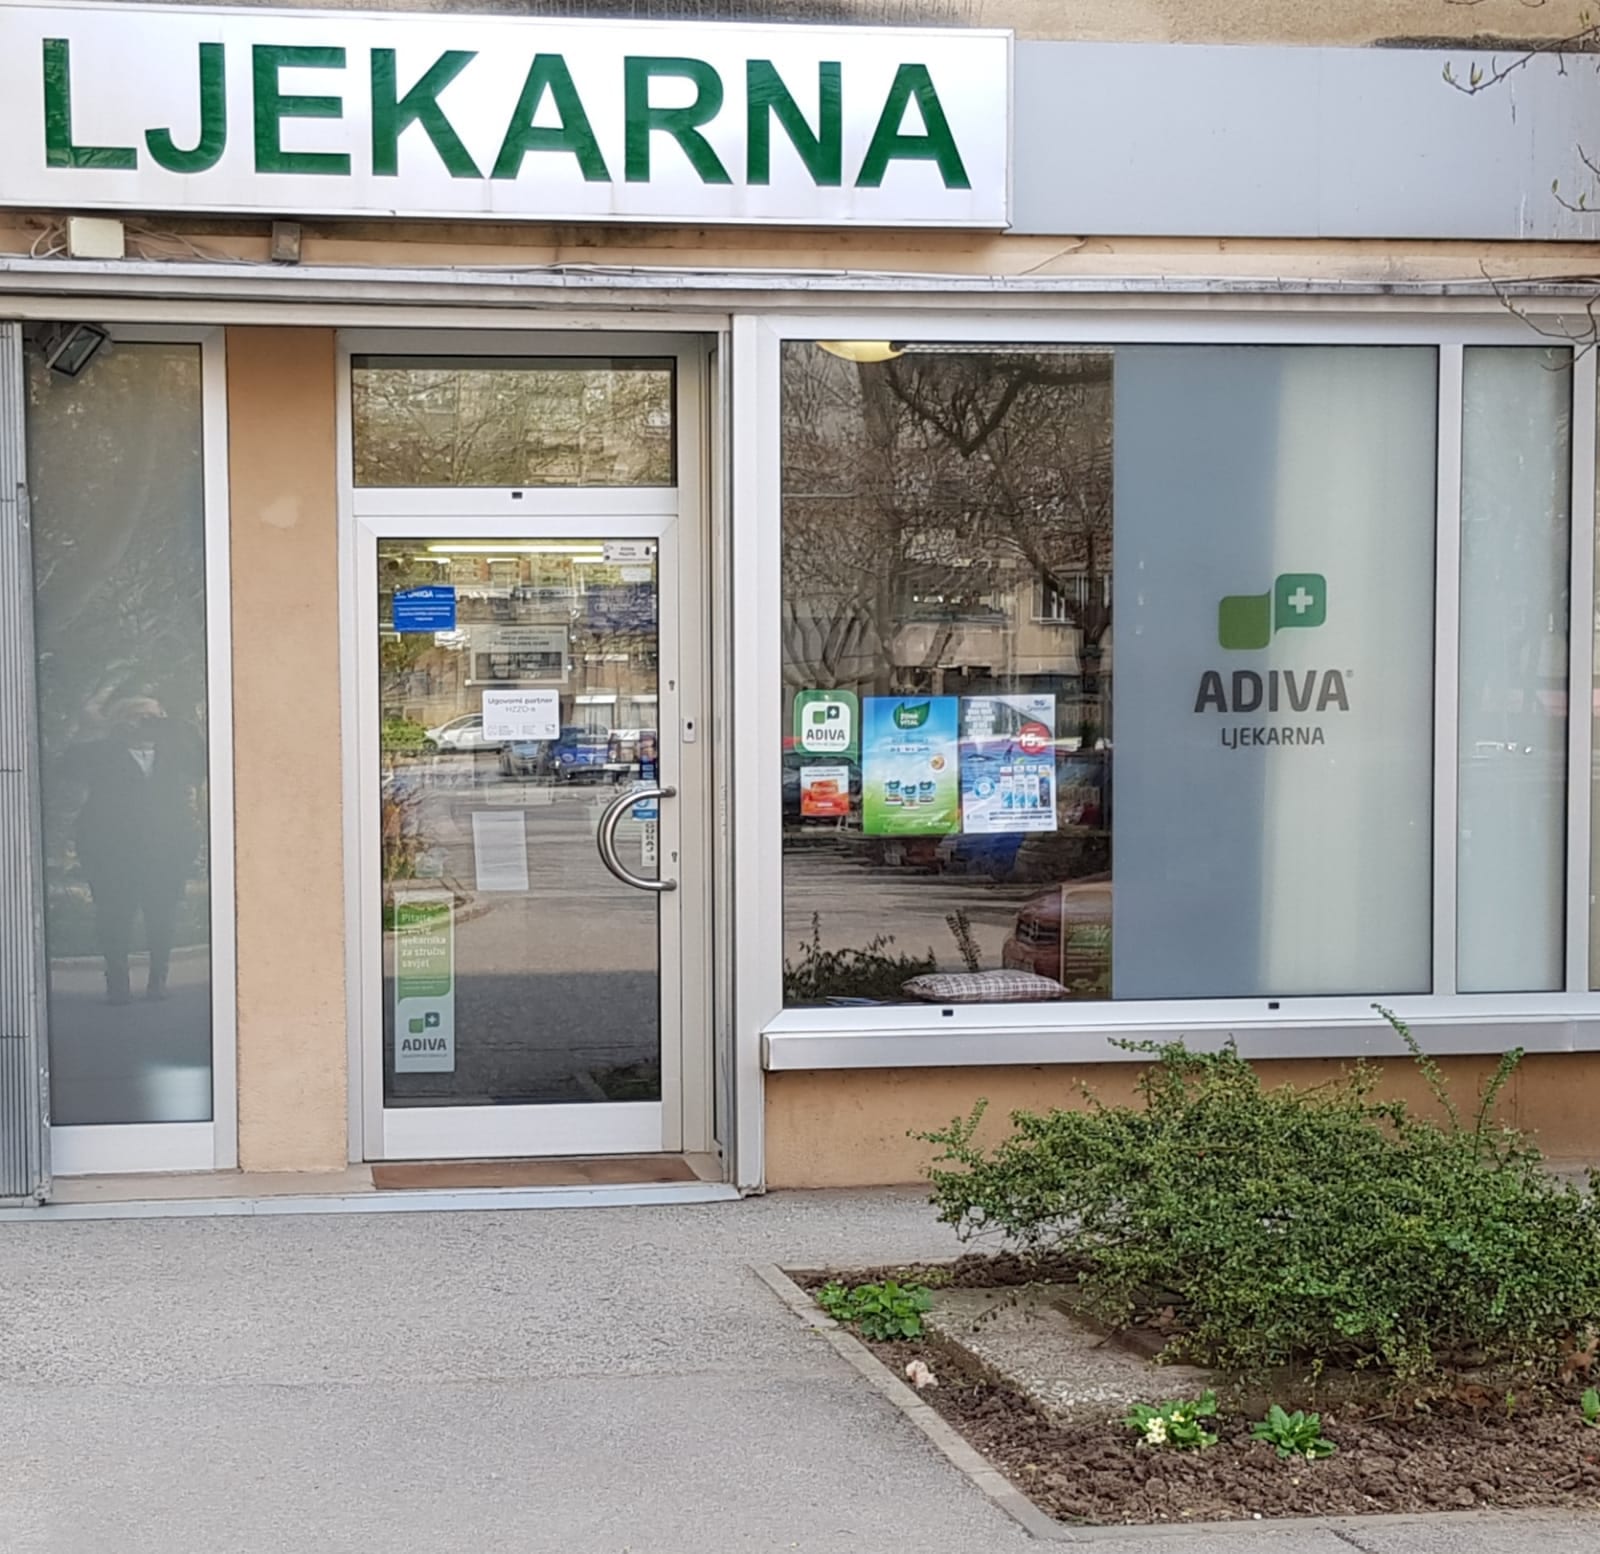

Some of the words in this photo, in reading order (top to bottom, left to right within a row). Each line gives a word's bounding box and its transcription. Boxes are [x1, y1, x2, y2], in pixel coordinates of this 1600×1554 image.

[42, 37, 972, 190] LJEKARNA
[1194, 669, 1350, 713] ADIVA
[487, 697, 523, 706] Ugovorni
[525, 697, 553, 705] partner
[806, 728, 846, 741] ADIVA
[1220, 726, 1325, 750] LJEKARNA
[401, 1038, 448, 1052] ADIVA
